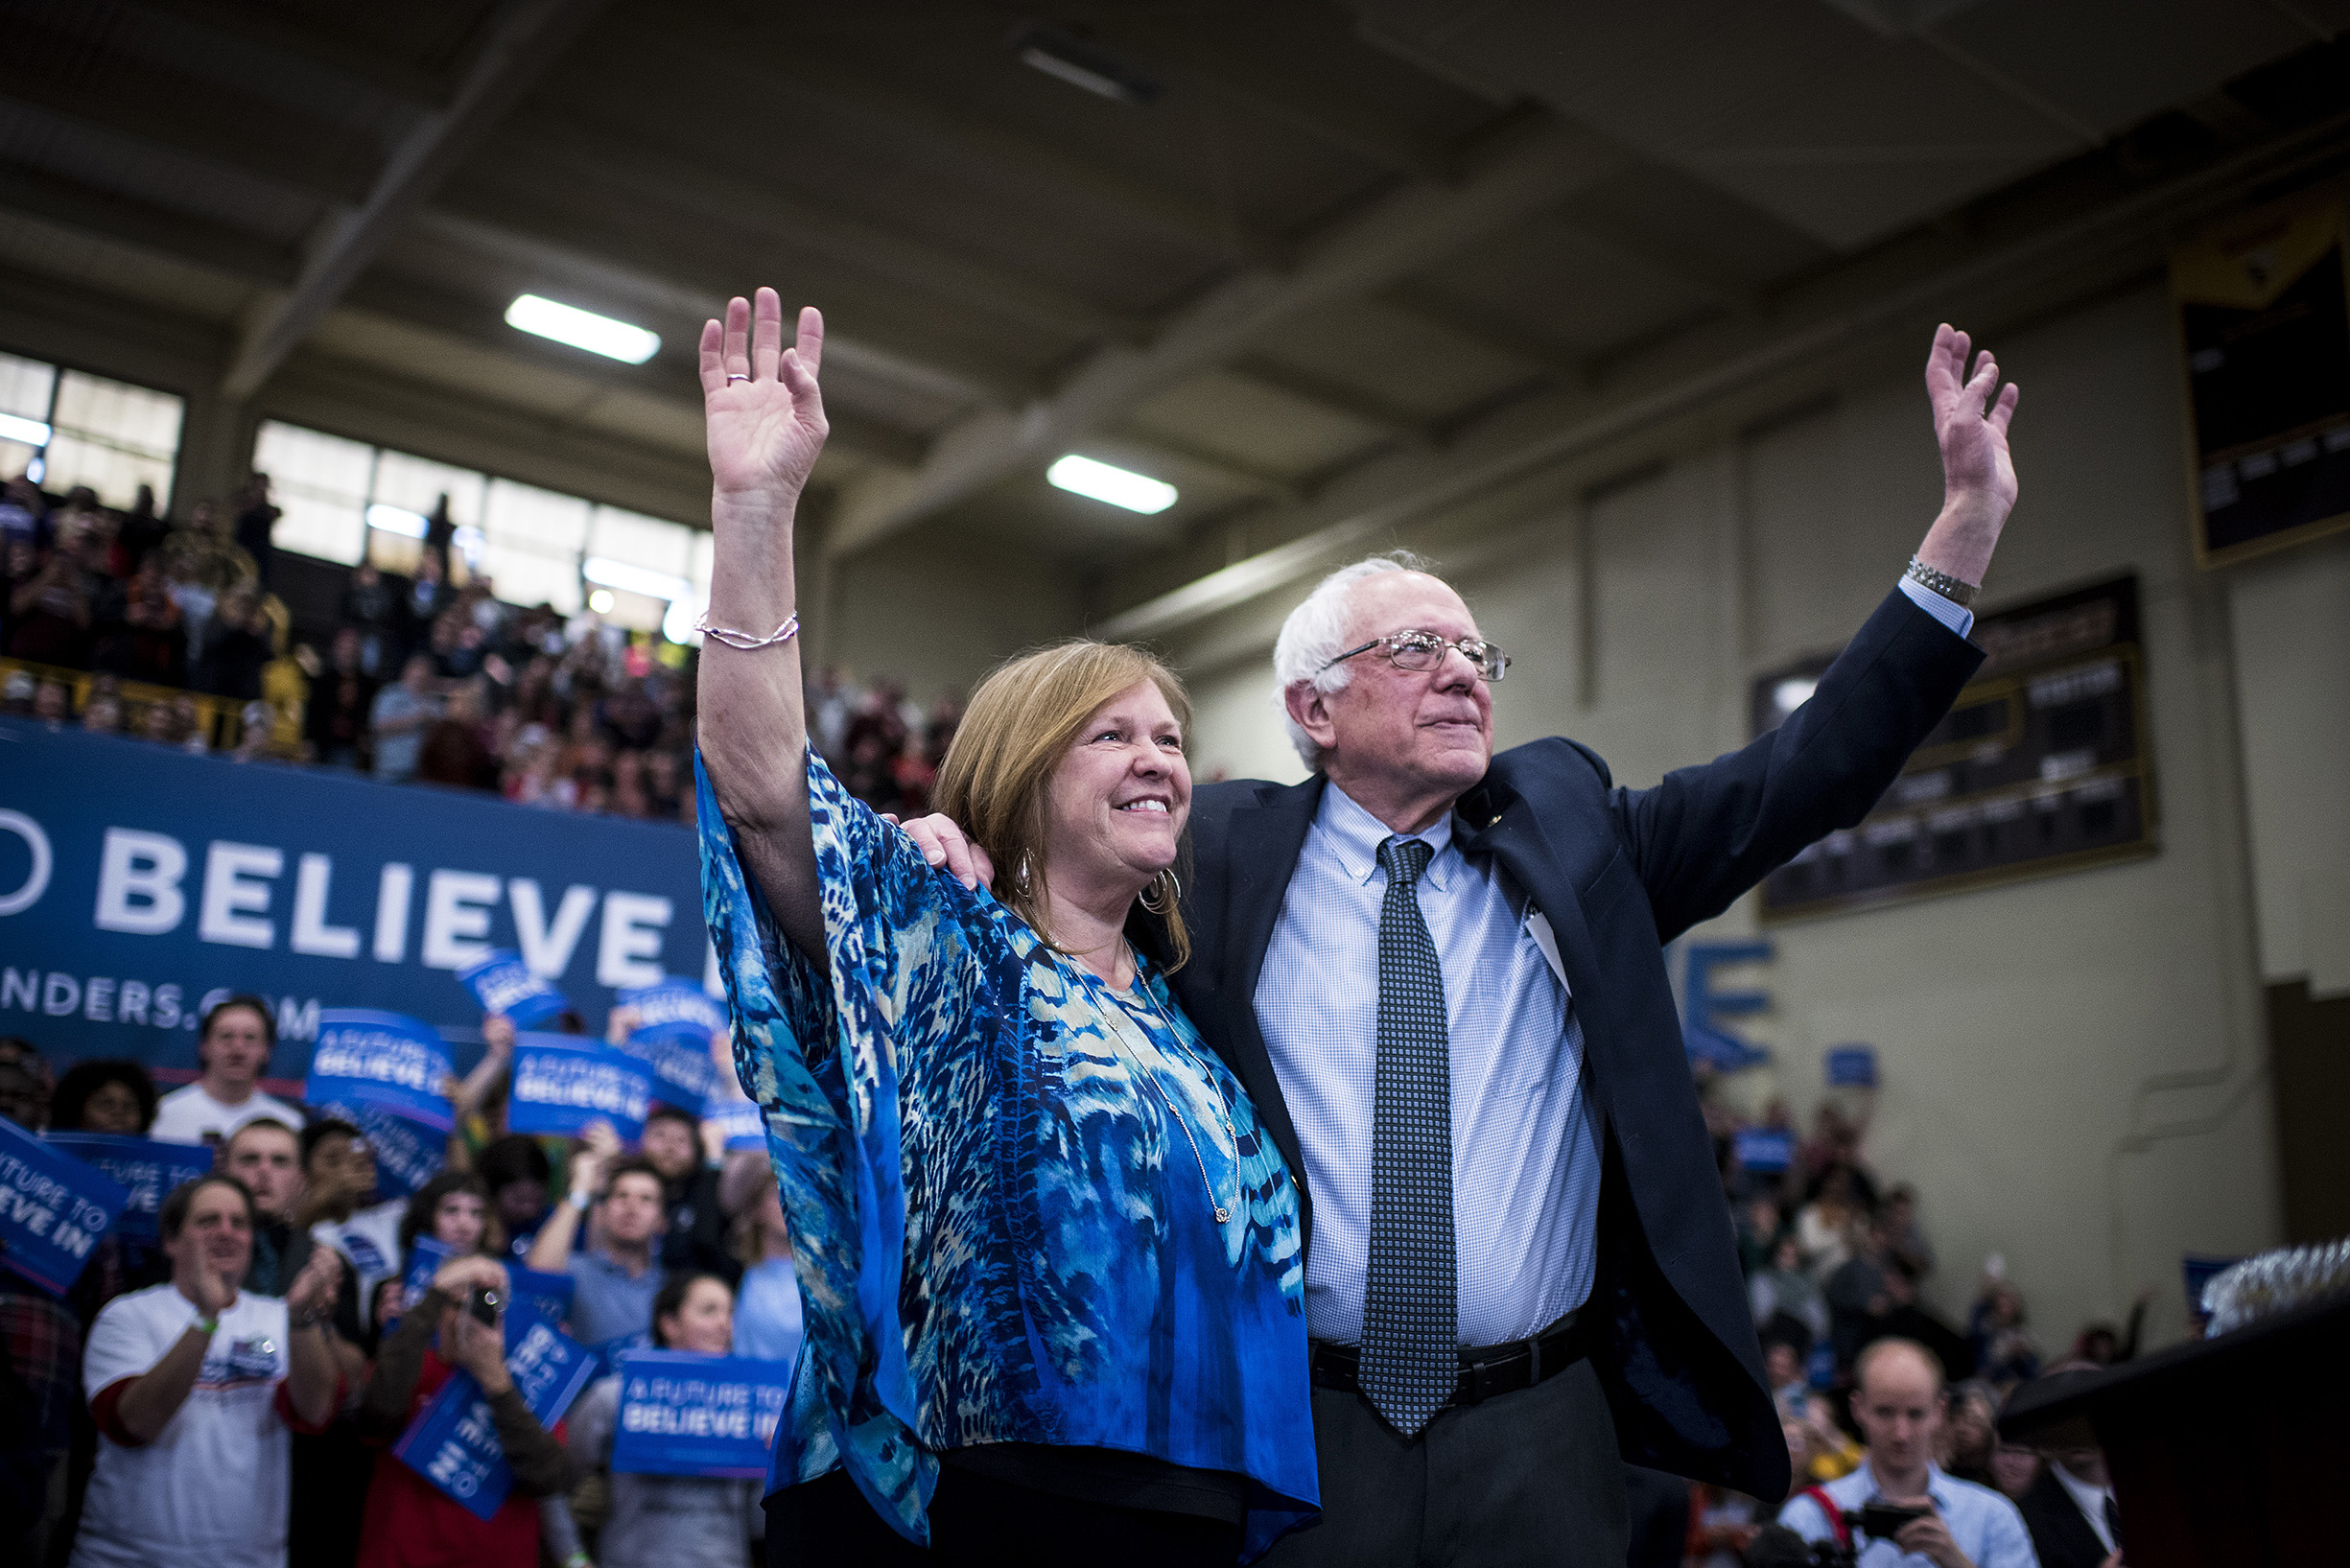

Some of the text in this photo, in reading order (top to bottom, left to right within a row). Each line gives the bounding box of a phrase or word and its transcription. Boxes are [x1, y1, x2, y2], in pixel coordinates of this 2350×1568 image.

[94, 826, 672, 989] BELIEVE
[70, 1197, 108, 1232] TO
[51, 1219, 94, 1259] IN
[626, 1377, 649, 1400] A
[650, 1377, 750, 1407] FUTURE
[623, 1402, 750, 1439] BELIEVE
